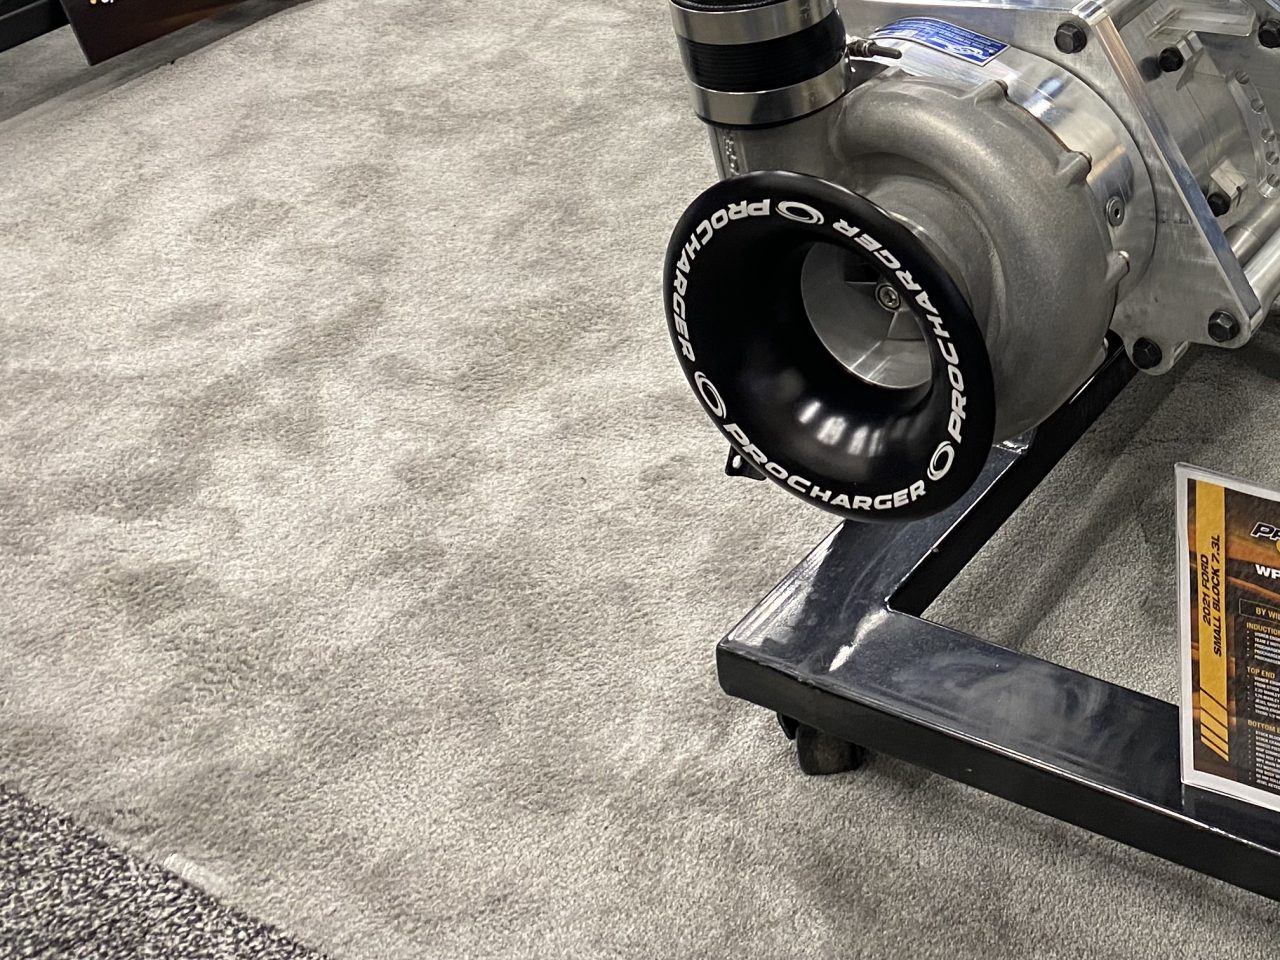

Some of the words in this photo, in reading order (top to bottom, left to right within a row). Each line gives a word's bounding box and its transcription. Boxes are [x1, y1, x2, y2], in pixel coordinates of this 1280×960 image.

[672, 198, 771, 363] PROCHARGER
[832, 218, 968, 444] PROCHARGER
[721, 422, 927, 512] PROCHARGER
[1211, 533, 1219, 564] 7.3L
[1200, 554, 1209, 589] FORD
[1211, 565, 1220, 612] BLOCK
[1202, 591, 1210, 626] 2021
[1255, 606, 1265, 616] BY
[1212, 613, 1221, 656] SMALL
[1247, 666, 1259, 675] TOP
[1262, 670, 1275, 679] END
[1247, 719, 1275, 732] BOTTOM
